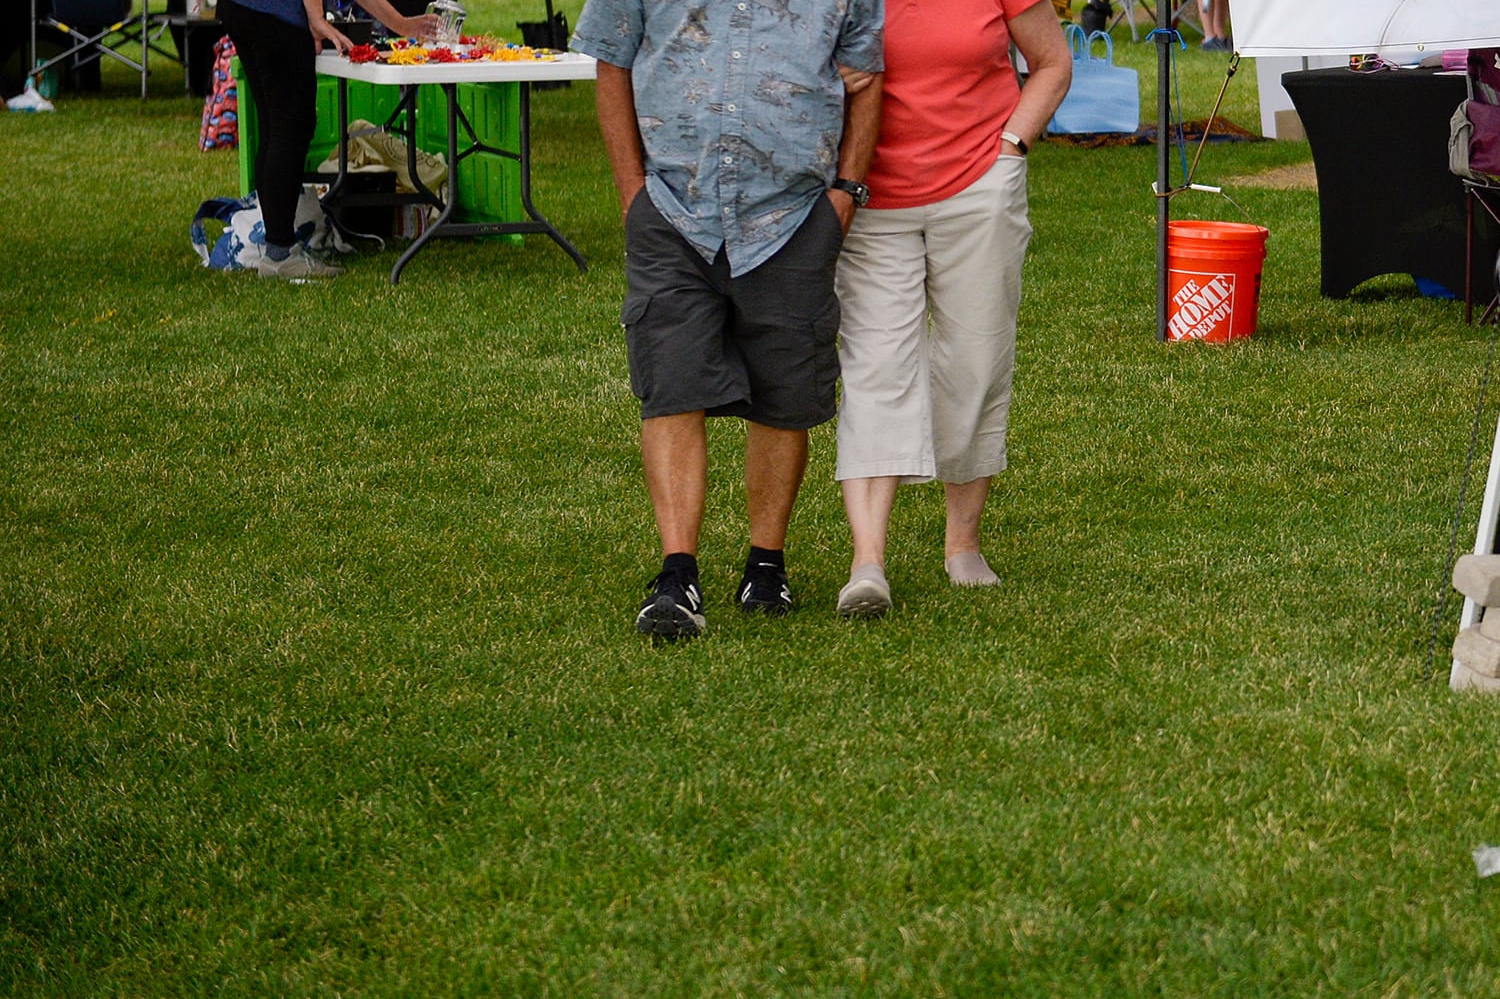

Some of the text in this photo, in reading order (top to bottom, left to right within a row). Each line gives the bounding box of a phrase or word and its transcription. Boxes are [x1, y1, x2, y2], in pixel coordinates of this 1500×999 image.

[1168, 274, 1234, 340] HOME
[1172, 278, 1201, 307] THE
[1188, 300, 1233, 339] DEPOT
